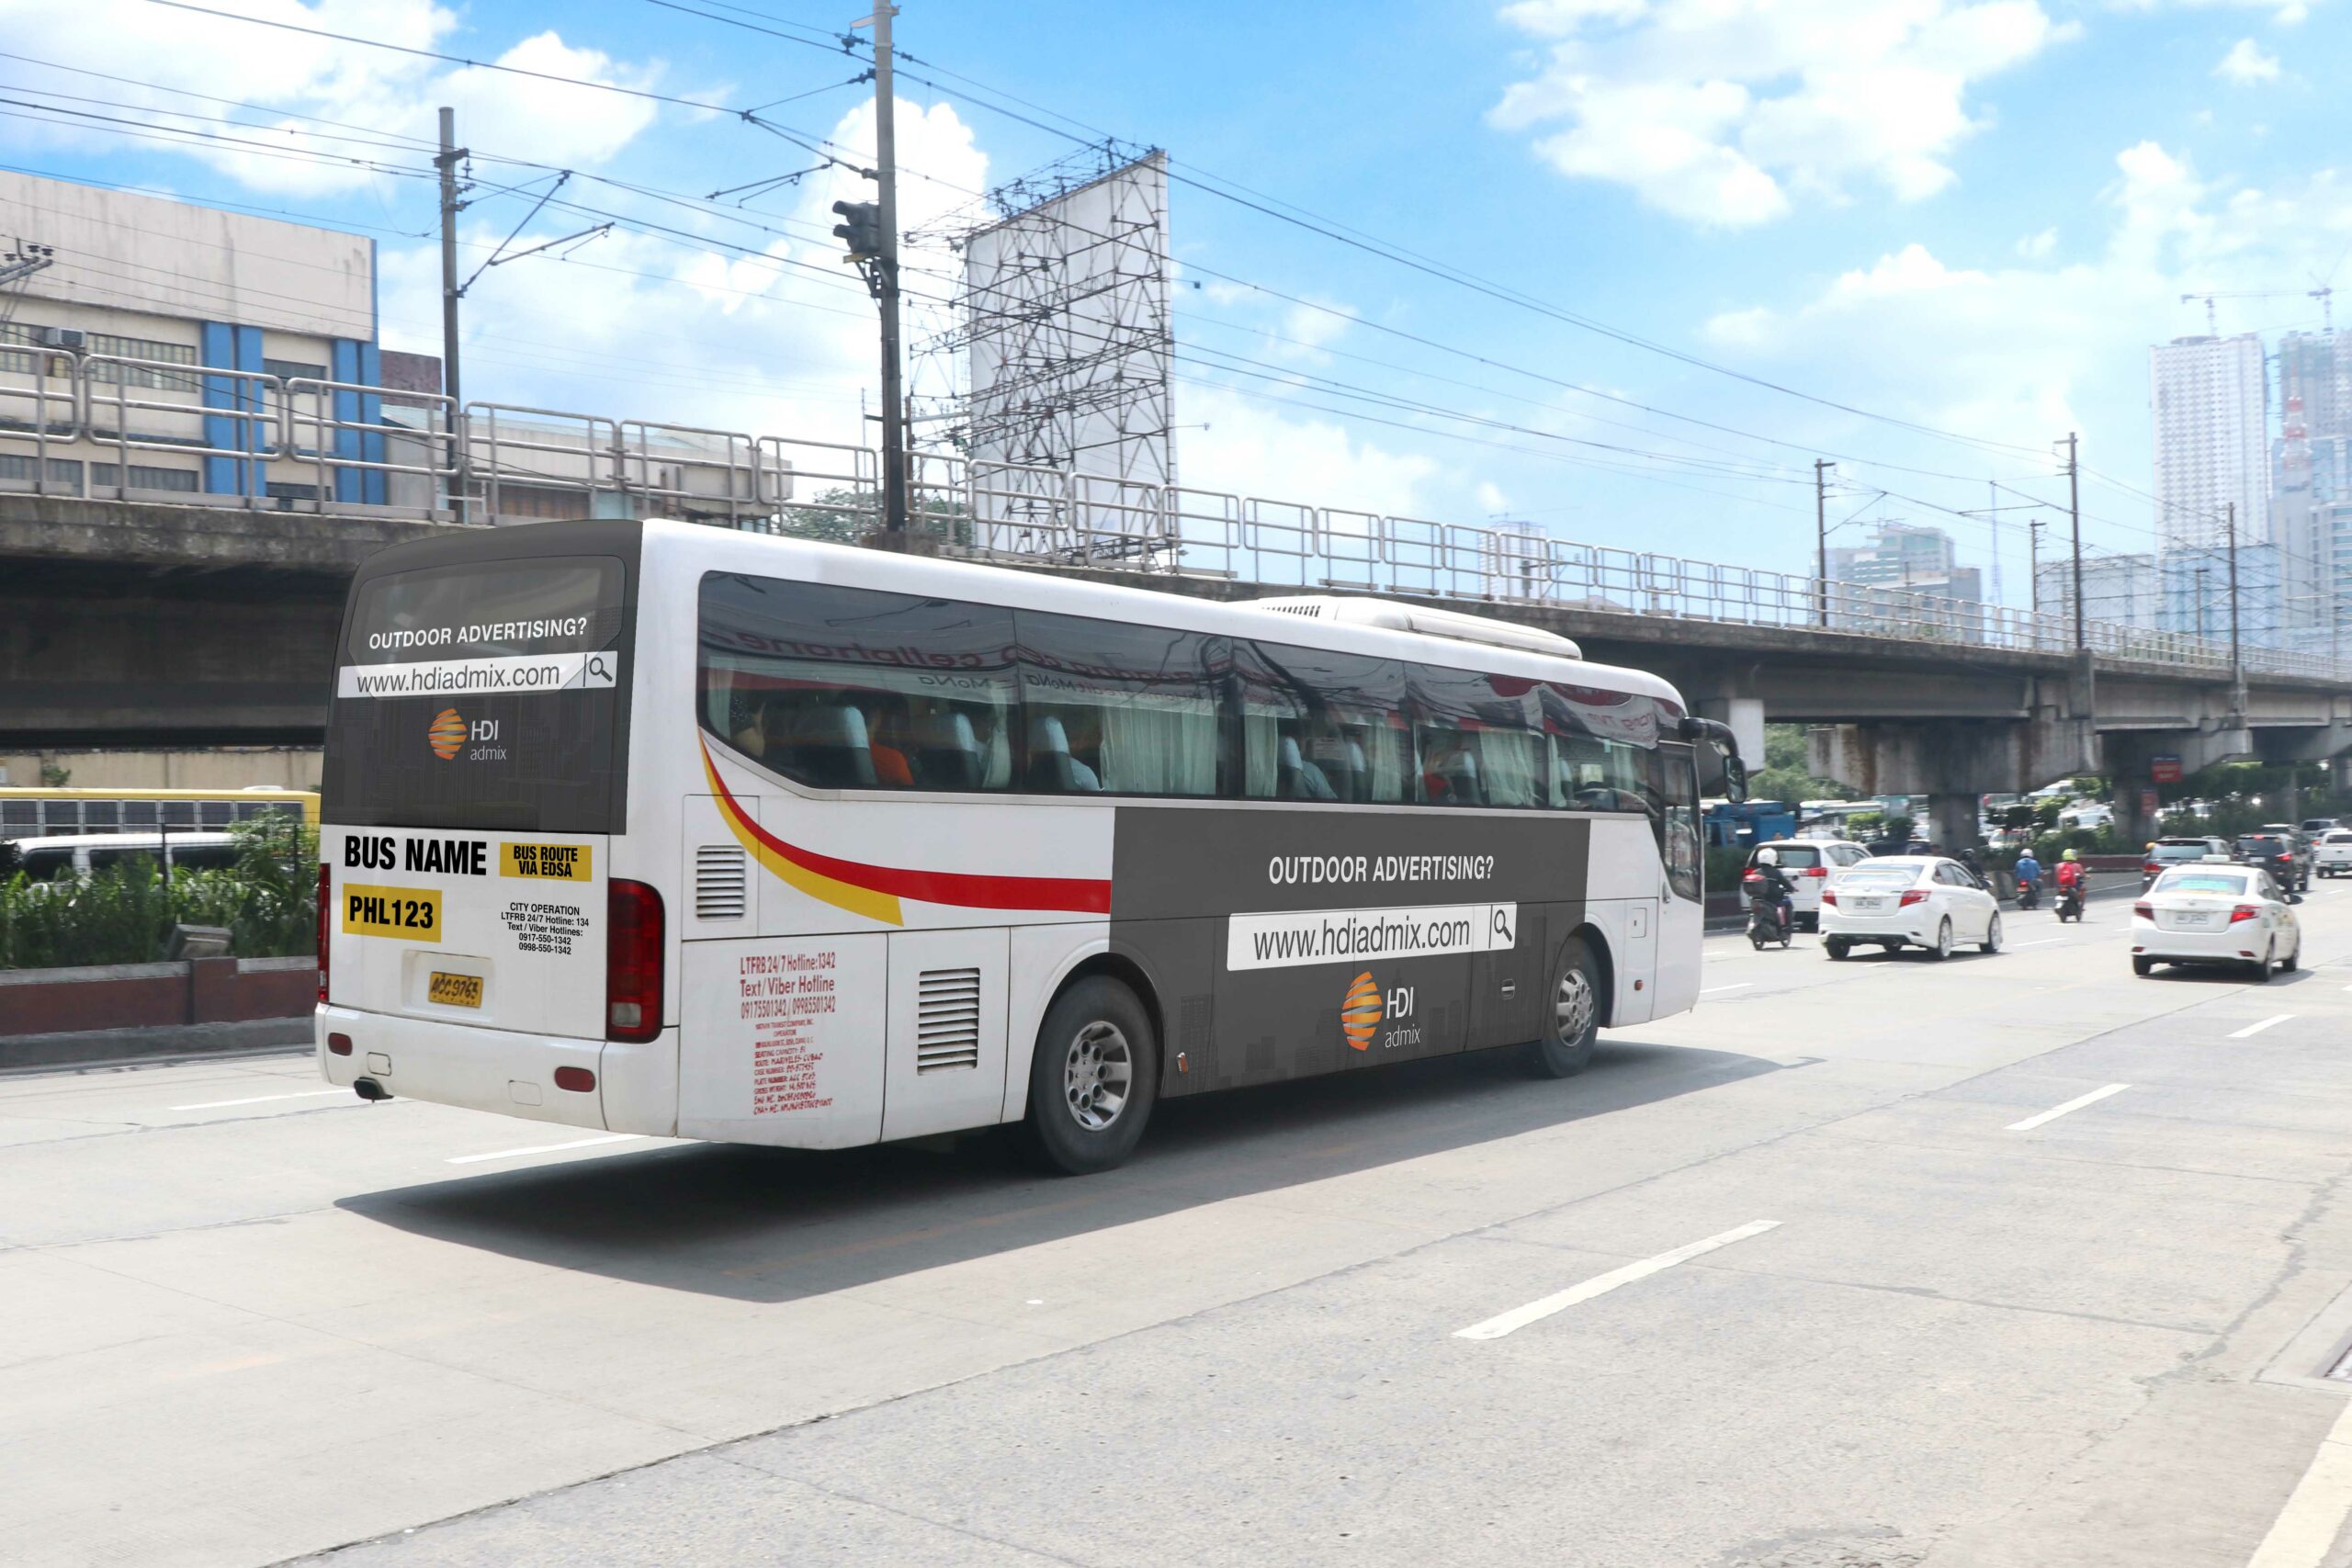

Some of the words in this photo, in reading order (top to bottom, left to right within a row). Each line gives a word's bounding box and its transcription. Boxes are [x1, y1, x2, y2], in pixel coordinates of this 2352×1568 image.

[368, 627, 451, 649] OUTDOOR
[457, 617, 588, 643] ADVERTISING?
[357, 664, 560, 693] www.hdiadmix.com
[471, 719, 499, 741] HDI
[470, 746, 507, 761] admix
[345, 835, 396, 870] BUS
[405, 838, 487, 876] NAME
[514, 845, 537, 862] BUS
[540, 846, 578, 863] ROUTE
[518, 861, 538, 875] VIA
[541, 862, 572, 878] EDSA
[1269, 856, 1367, 885] OUTDOOR
[1373, 855, 1494, 882] ADVERTISING?
[349, 896, 434, 929] PHL123
[510, 902, 529, 911] CITY
[531, 903, 580, 916] OPERATION
[501, 911, 526, 921] LTFRB
[527, 913, 544, 922] 24/7
[546, 915, 574, 926] Hotline:
[576, 918, 589, 927] 134
[507, 921, 523, 931] Text
[528, 923, 548, 933] Viber
[549, 925, 583, 937] Hotlines:
[518, 932, 571, 945] 0917-550-1342
[1254, 915, 1470, 961] www.hdiadmix.com
[518, 942, 571, 955] 0998-550-1342
[740, 956, 766, 975] LTFRB
[798, 975, 834, 993] Hotline
[1385, 986, 1414, 1020] HDI
[1385, 1023, 1421, 1048] admix
